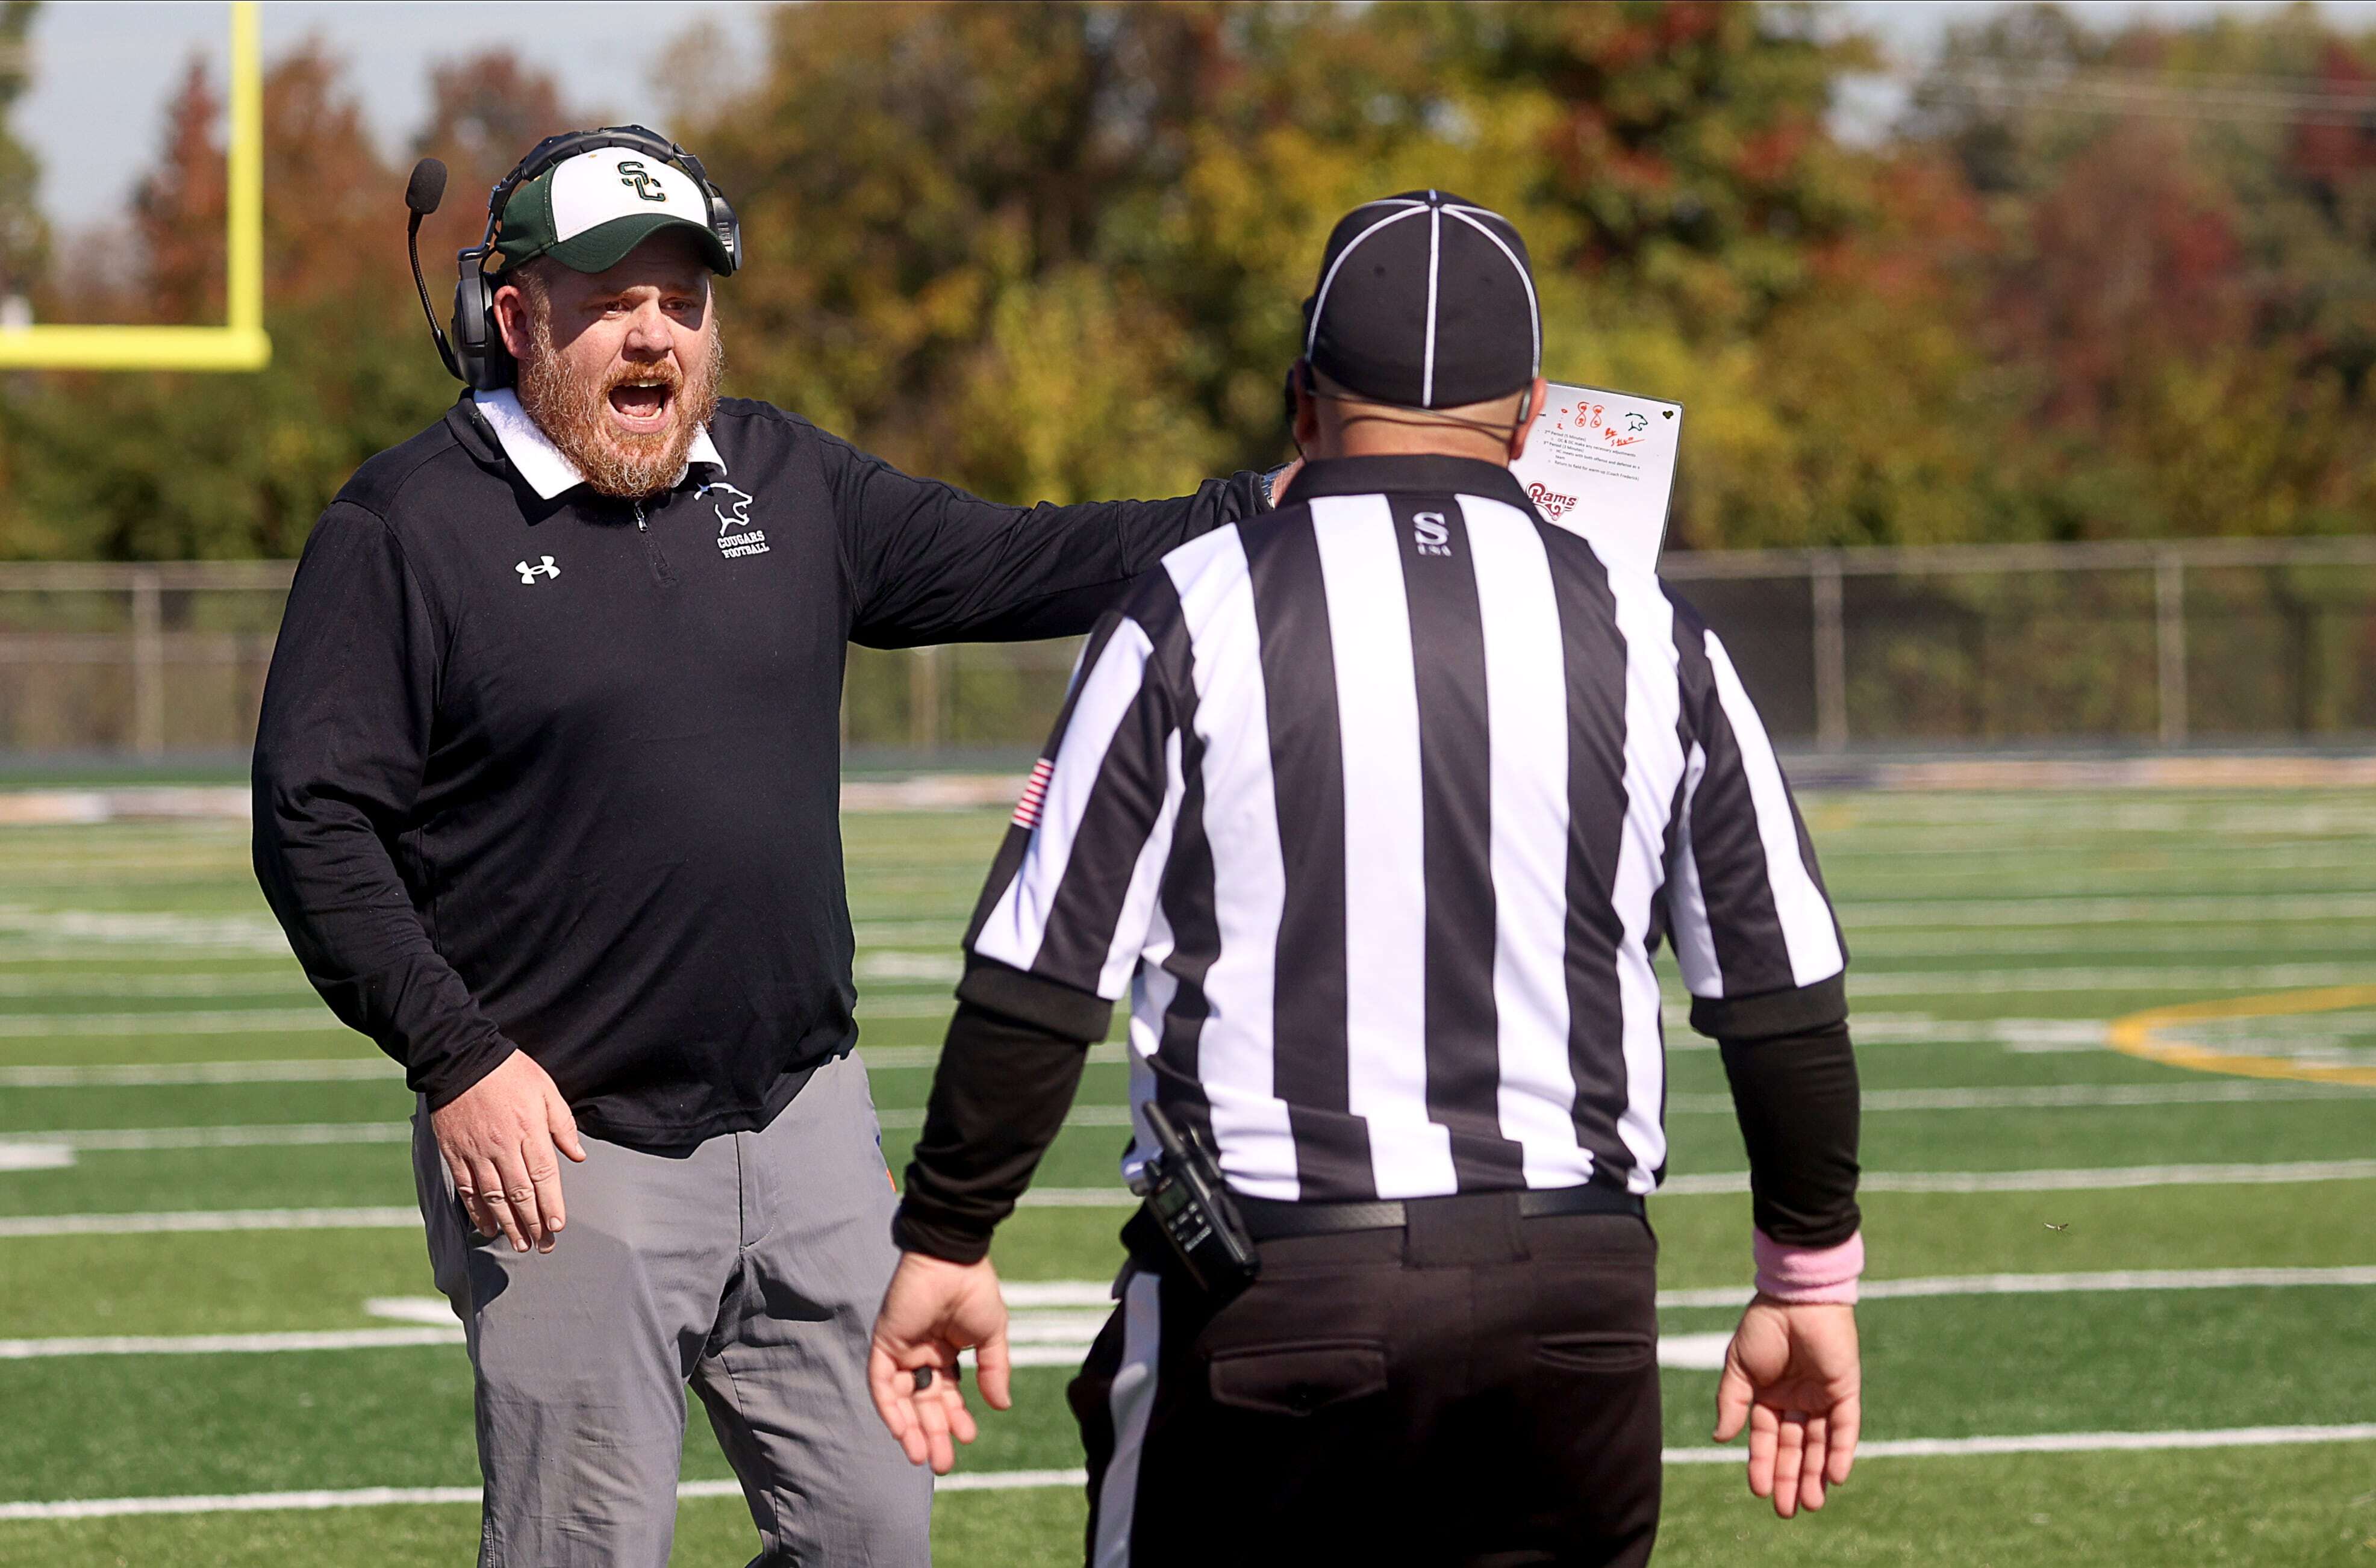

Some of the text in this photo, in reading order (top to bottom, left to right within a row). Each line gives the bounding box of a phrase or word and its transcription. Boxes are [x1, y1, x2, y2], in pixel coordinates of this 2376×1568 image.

[617, 161, 666, 202] SC
[1527, 482, 1577, 509] Rams
[717, 530, 765, 549] COUGARS
[1412, 512, 1449, 546] S
[722, 543, 770, 558] FOOTBALL
